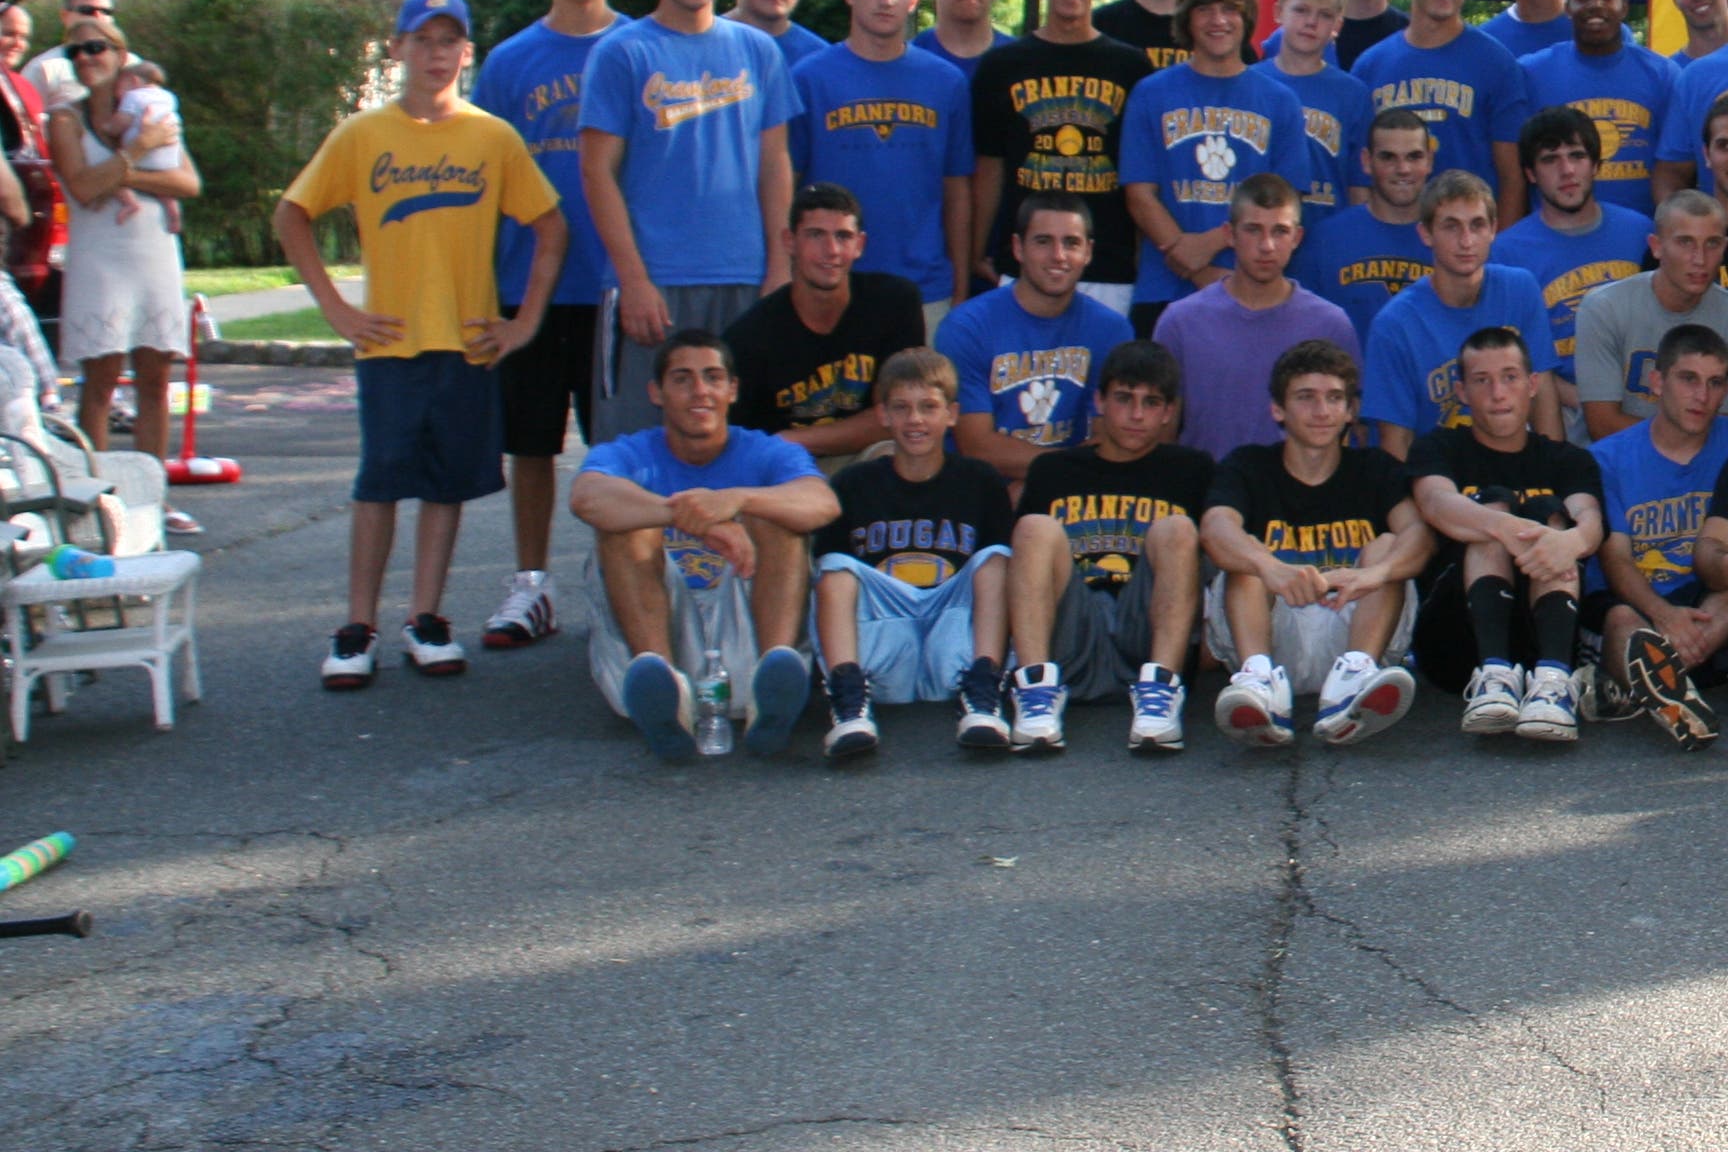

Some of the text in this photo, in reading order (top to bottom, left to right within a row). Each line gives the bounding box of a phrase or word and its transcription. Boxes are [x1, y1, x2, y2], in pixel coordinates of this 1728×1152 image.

[525, 73, 583, 121] CRAN
[825, 101, 939, 132] CRANFORD
[1010, 75, 1127, 117] CRANFORD
[1162, 105, 1272, 156] CRANFORD
[370, 151, 487, 194] Cranford
[1016, 167, 1063, 190] STATE
[1339, 259, 1436, 287] CRANFOR
[1625, 491, 1715, 541] CRANF
